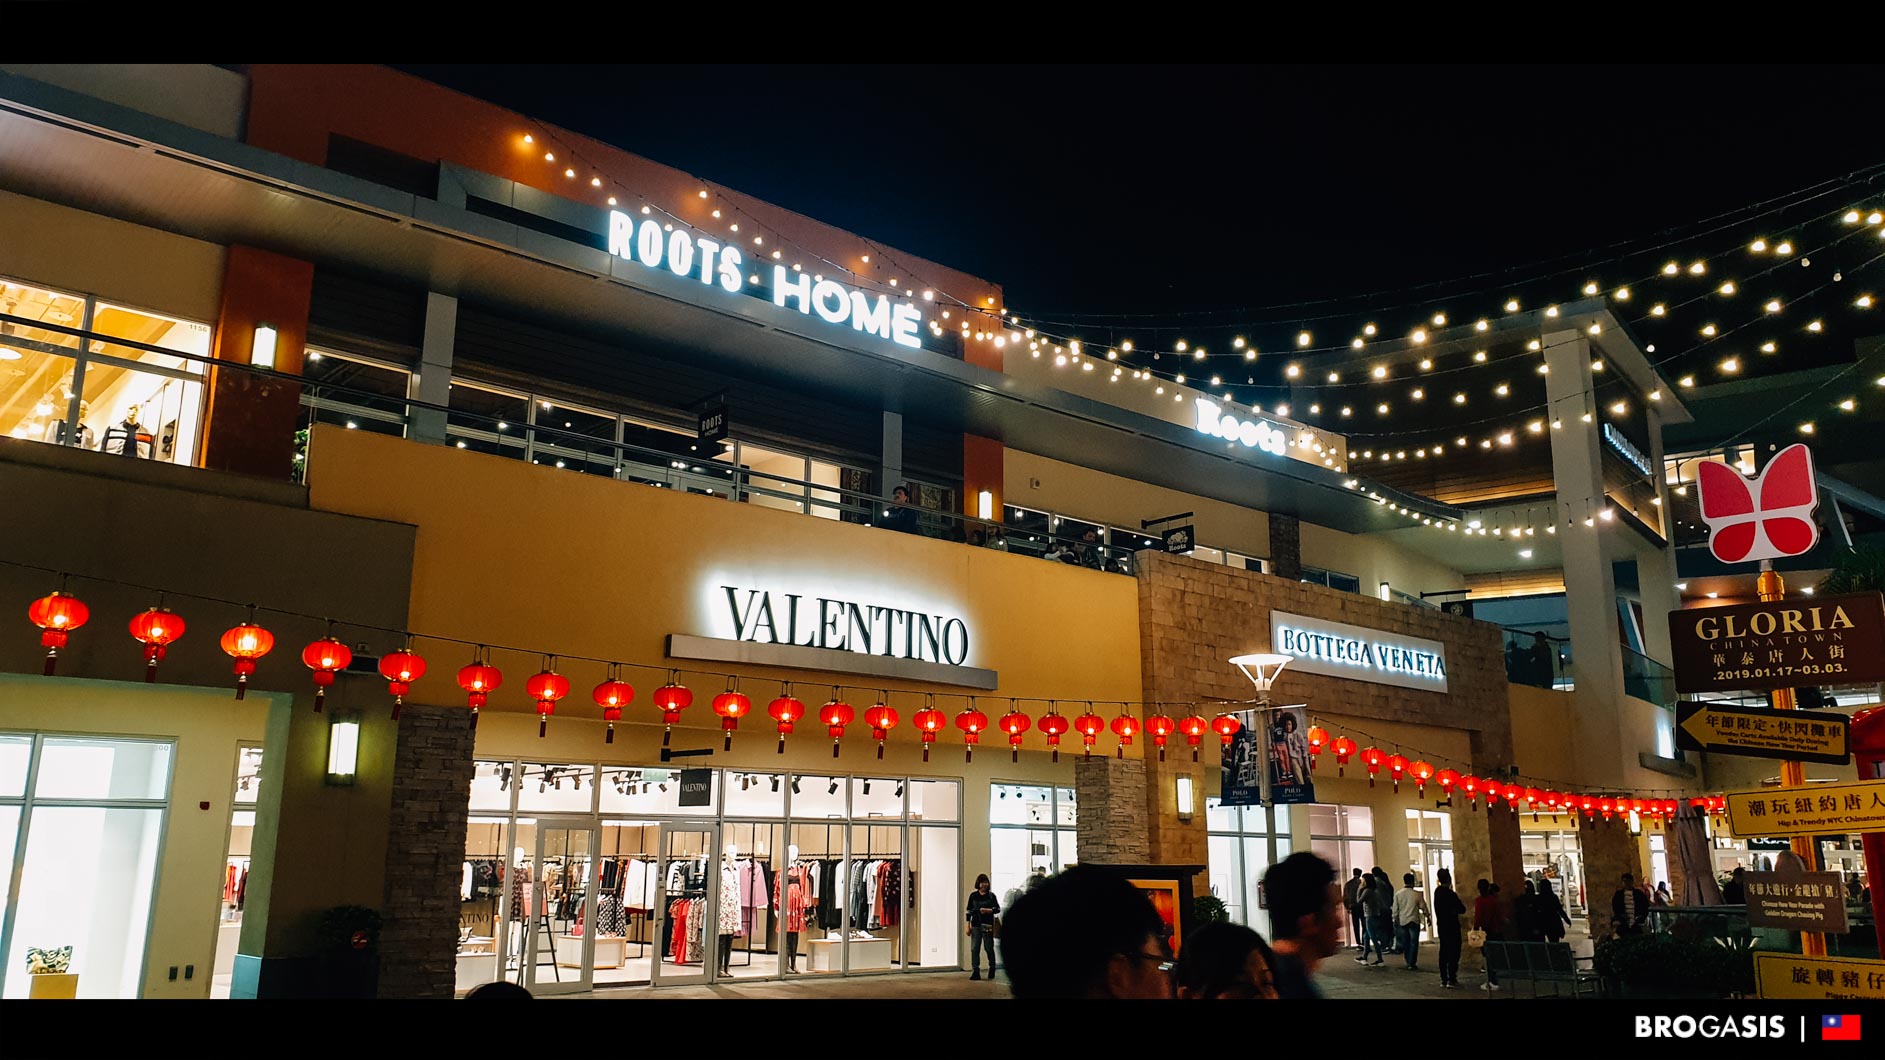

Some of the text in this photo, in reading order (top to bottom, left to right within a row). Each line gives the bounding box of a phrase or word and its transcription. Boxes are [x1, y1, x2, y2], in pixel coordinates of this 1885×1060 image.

[607, 209, 923, 350] ROOTS HOME
[701, 413, 722, 432] ROOTS
[1195, 397, 1286, 456] Roots
[720, 585, 969, 666] VALENTINO
[1695, 605, 1855, 641] GLORIA
[1284, 629, 1446, 676] BOTTEGA VENETA
[1709, 632, 1843, 651] CHINATOWN
[1713, 644, 1845, 667] 華泰唐人街
[682, 783, 707, 792] VALENTINO
[1748, 792, 1885, 817] 潮玩紐約唐人
[1800, 818, 1826, 826] Trendy
[1827, 816, 1843, 824] NYC
[1780, 910, 1797, 919] Dragon
[1815, 912, 1824, 920] Pig
[1791, 966, 1885, 990] 旋轉豬仔
